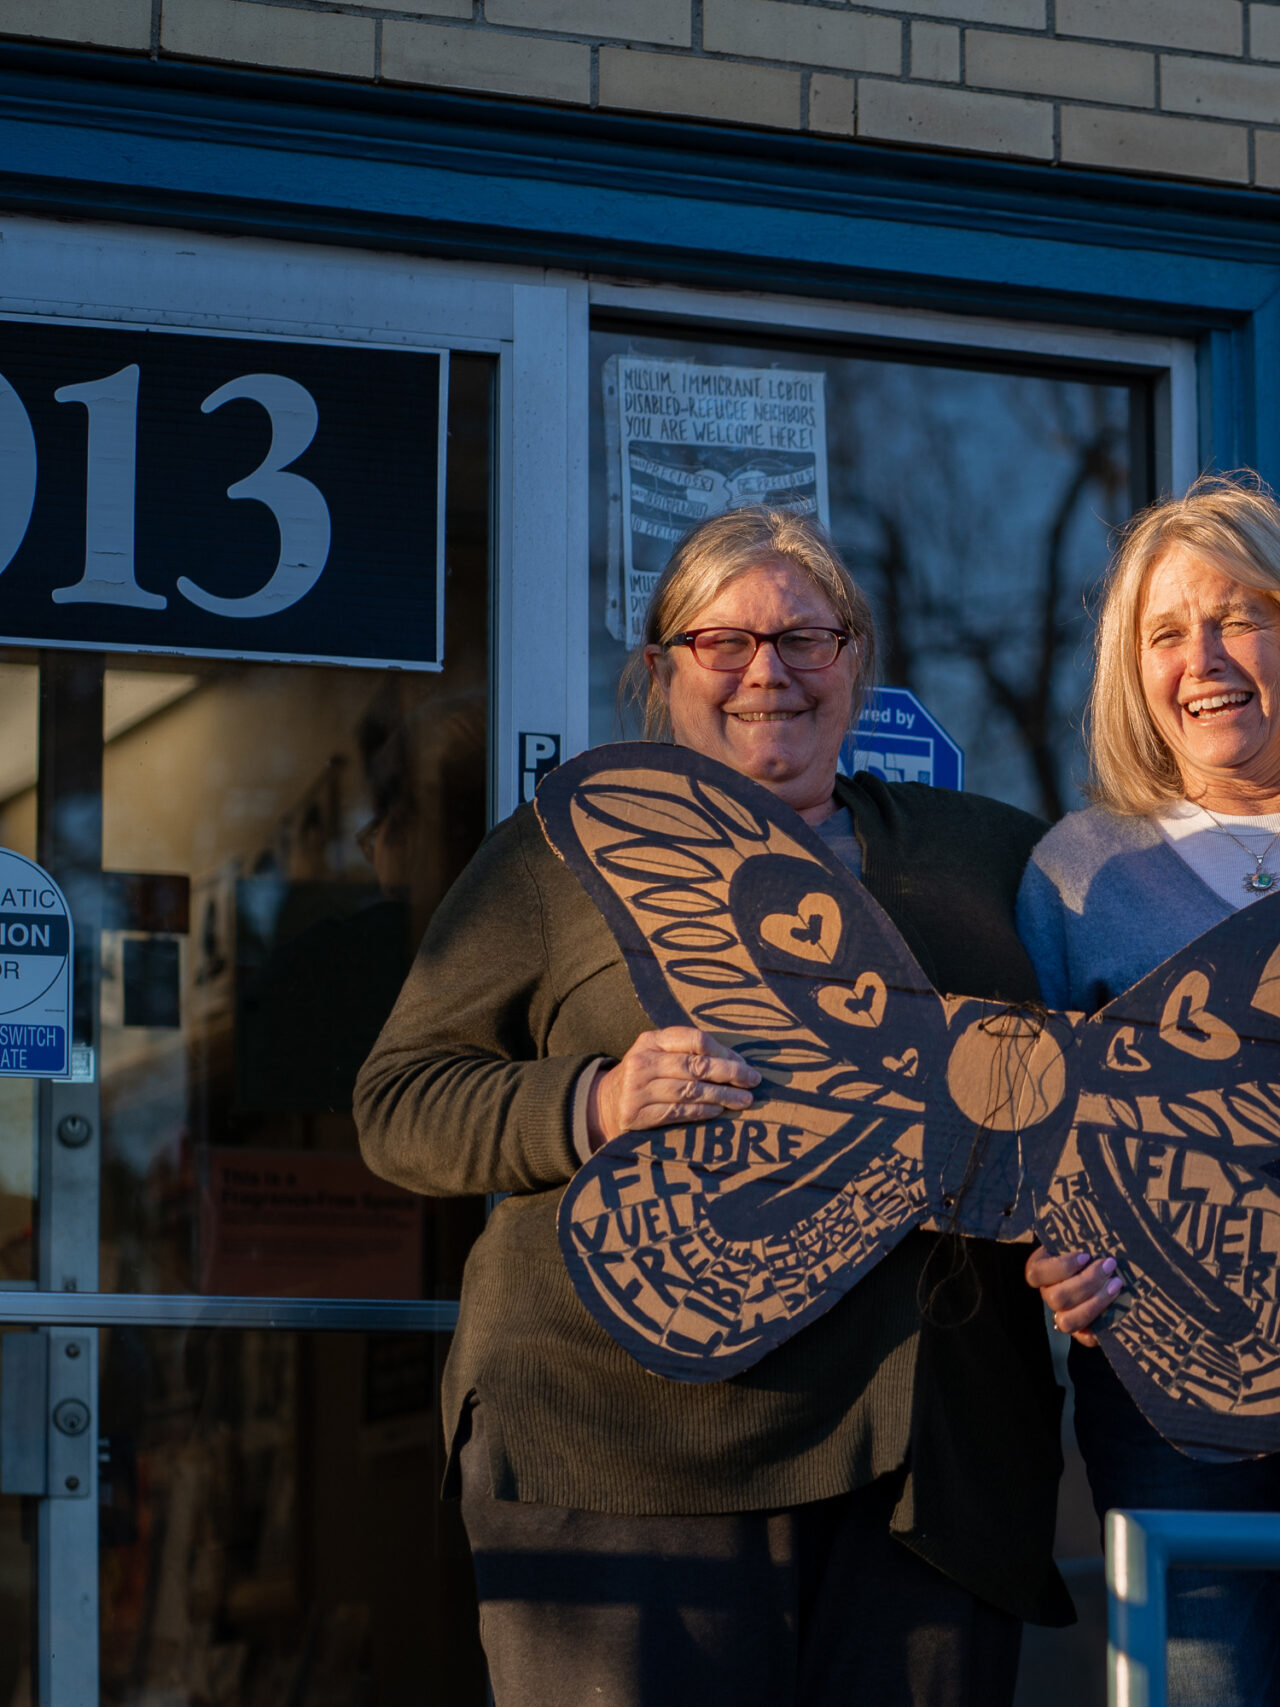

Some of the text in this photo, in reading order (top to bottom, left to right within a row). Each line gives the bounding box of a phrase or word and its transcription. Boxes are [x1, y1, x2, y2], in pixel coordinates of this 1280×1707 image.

[626, 415, 814, 450] YOU ARE WELCOME HERE!
[0, 364, 331, 618] 13
[895, 709, 915, 729] by
[0, 1025, 56, 1047] SWITCH
[650, 1118, 804, 1169] LIBRE
[598, 1153, 750, 1210] FLY
[1139, 1142, 1266, 1206] FLY
[572, 1193, 708, 1251] VUELA
[587, 1228, 727, 1335] FREE
[667, 1248, 751, 1356] LIBRE
